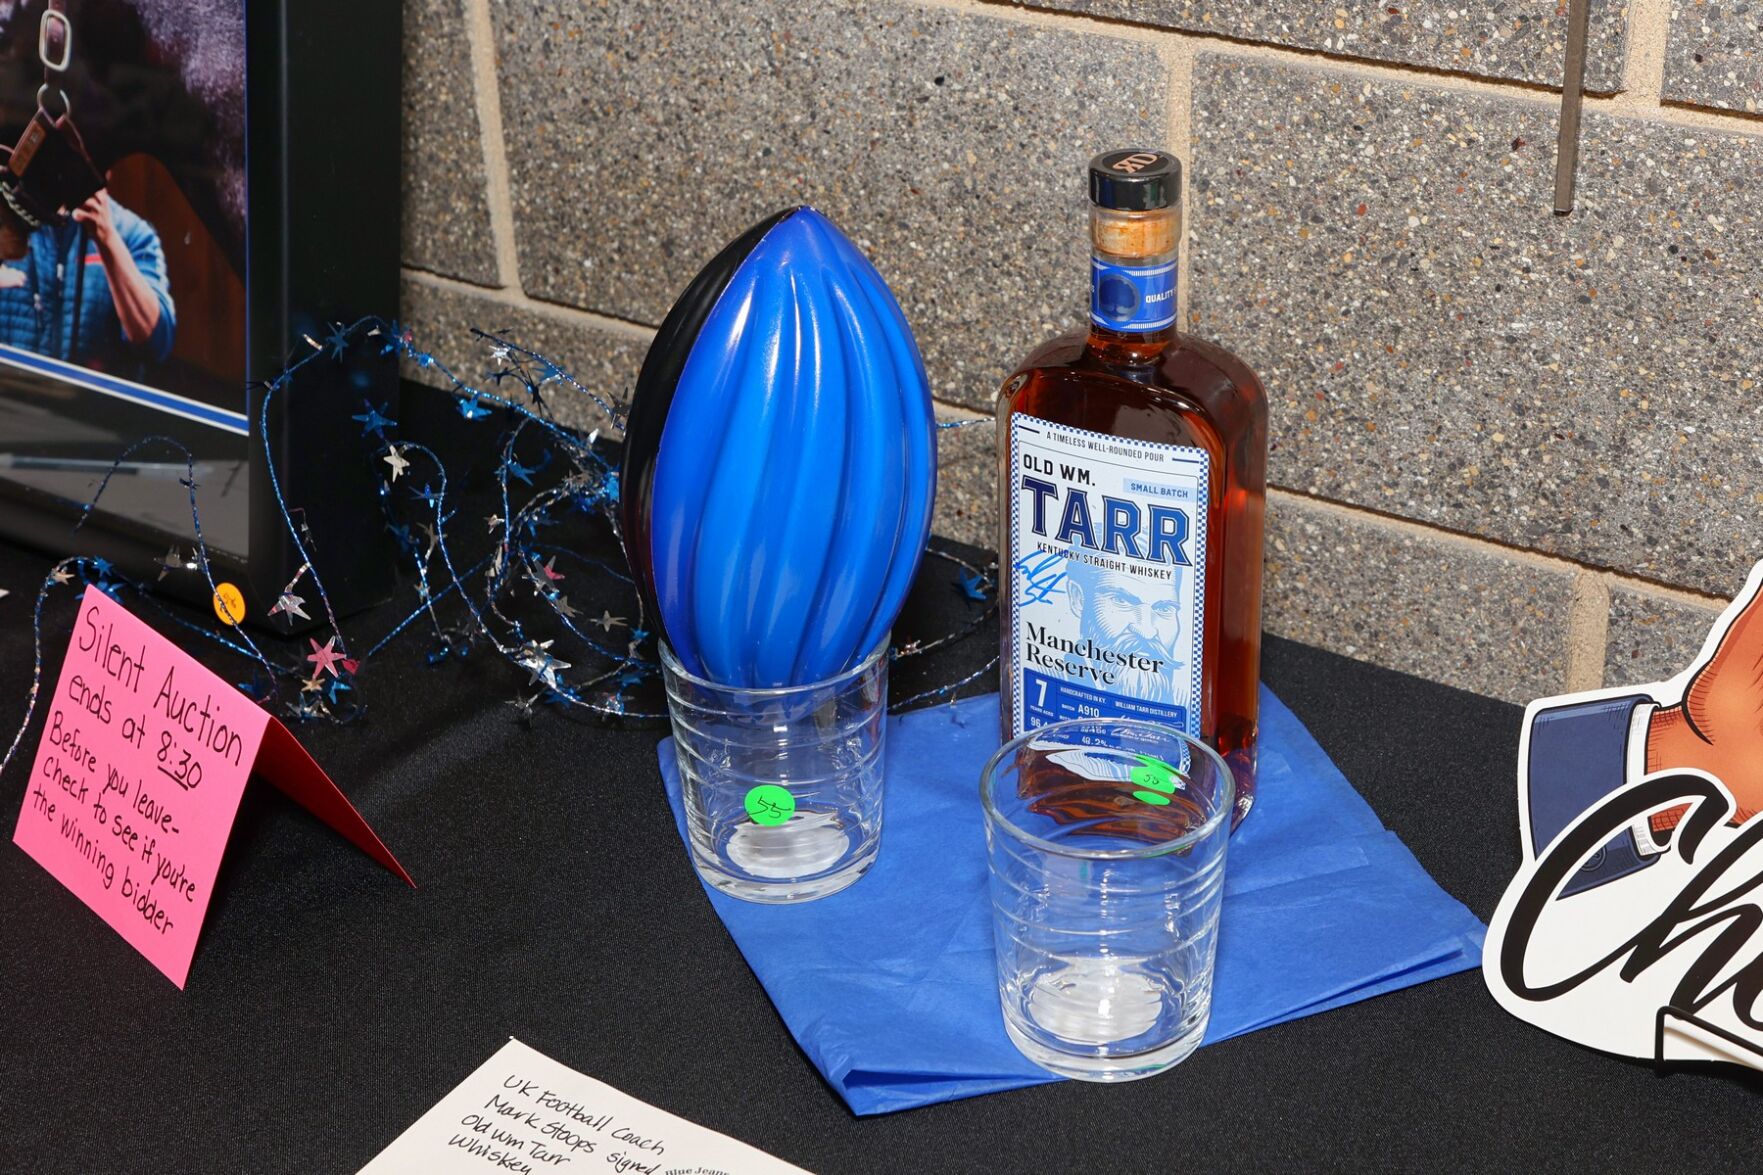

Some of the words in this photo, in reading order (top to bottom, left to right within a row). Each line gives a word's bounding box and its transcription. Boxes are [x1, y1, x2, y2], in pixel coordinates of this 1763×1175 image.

[1023, 453, 1053, 476] OLD
[1060, 463, 1096, 487] WM.
[1046, 431, 1052, 440] A
[1053, 432, 1086, 448] TIMELESS
[1088, 442, 1142, 459] WELL-ROUNDED
[1144, 452, 1164, 462] POUR
[1130, 482, 1158, 495] SMALL
[1160, 486, 1188, 499] BATCH
[1021, 474, 1193, 567] TARR
[1037, 541, 1081, 561] KENTUCKY
[1083, 554, 1128, 572] STRAIGHT
[1129, 566, 1172, 580] WHISKEY
[1026, 621, 1164, 673] Manchester
[1026, 641, 1115, 684] Reserve
[79, 606, 145, 693] Silent
[153, 666, 242, 767] Auction
[1035, 678, 1048, 707] 7
[1078, 704, 1100, 718] A910
[1136, 705, 1150, 714] TARR
[1150, 708, 1178, 718] DISTILLERY
[50, 711, 97, 773] Before
[103, 764, 129, 798] you
[69, 675, 112, 724] ends
[122, 714, 146, 749] at
[157, 730, 202, 789] 8:30
[33, 783, 56, 822] the
[60, 813, 115, 890] winning
[121, 866, 174, 934] bidder
[93, 792, 107, 824] to
[112, 815, 138, 851] see
[141, 836, 156, 864] if
[151, 853, 196, 902] you're
[461, 1114, 492, 1134] Old
[529, 1139, 571, 1166] Tarr
[484, 1094, 541, 1129] Mark
[541, 1121, 597, 1154] Stoops
[606, 1151, 662, 1175] signed
[503, 1074, 539, 1097] UK
[536, 1090, 613, 1132] Football
[611, 1127, 665, 1156] Coach
[448, 1133, 533, 1175] Whiskey
